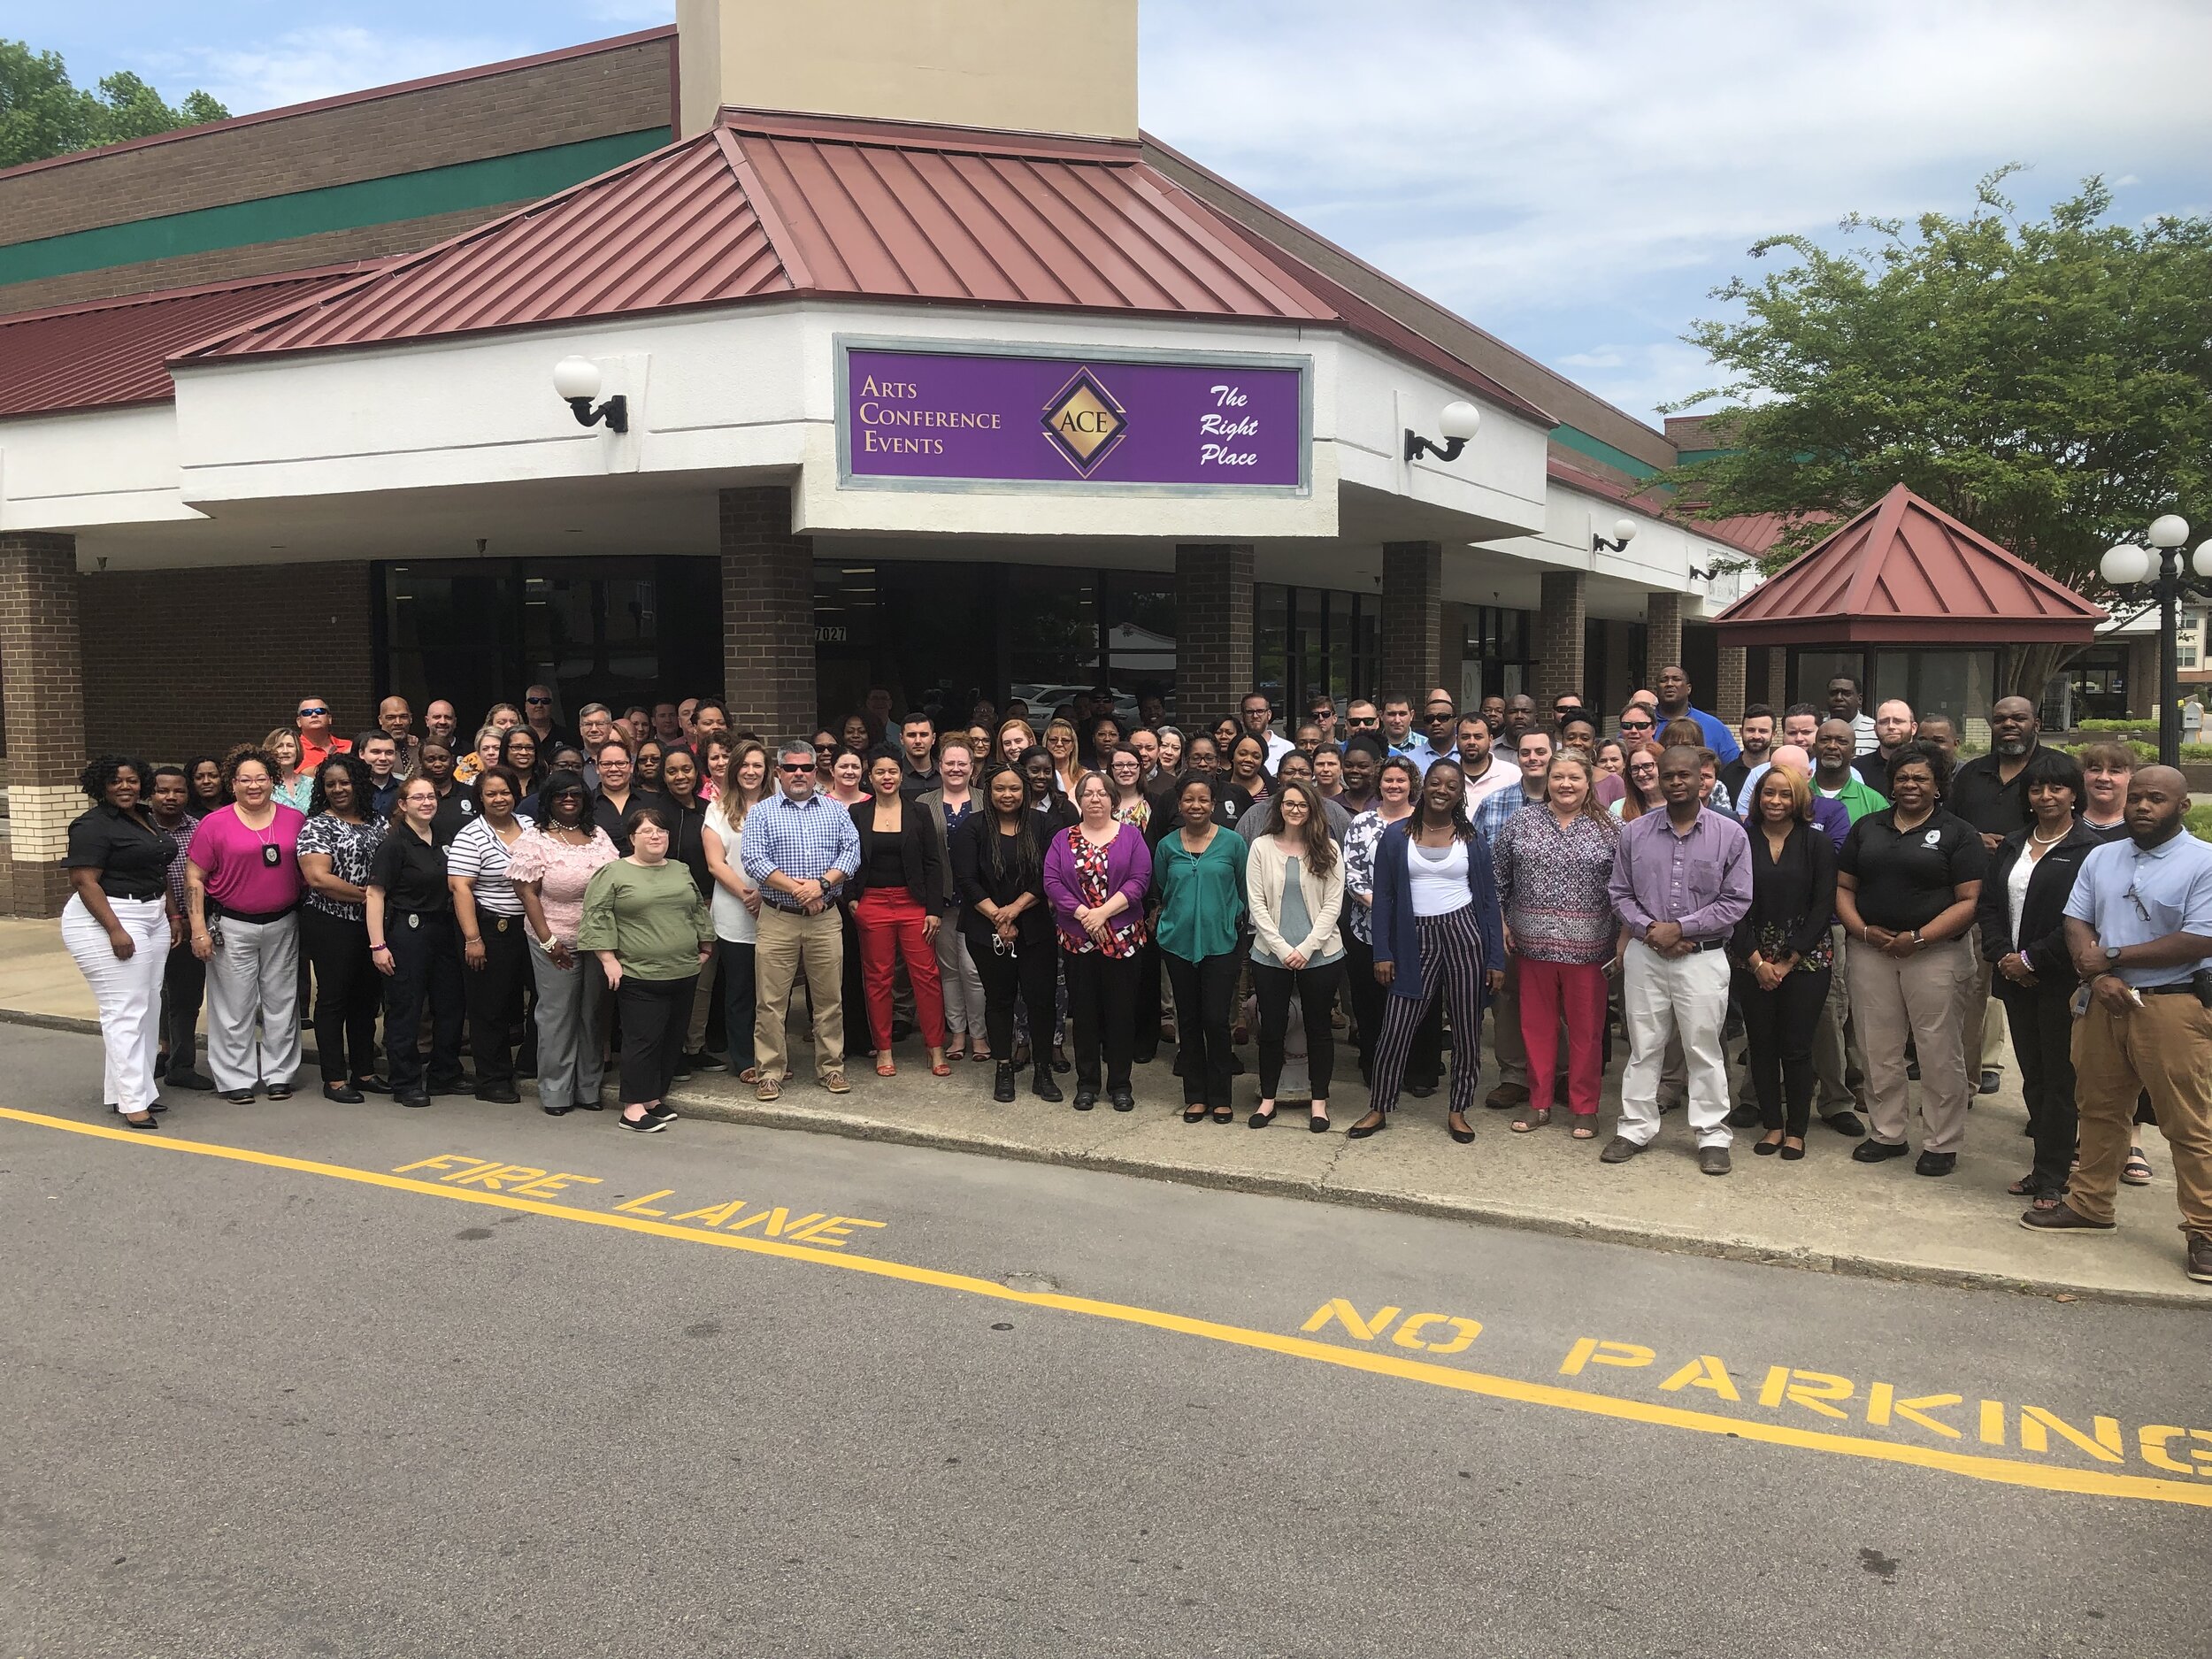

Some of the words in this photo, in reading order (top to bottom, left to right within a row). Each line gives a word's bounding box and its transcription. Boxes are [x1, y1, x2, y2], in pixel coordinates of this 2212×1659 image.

[859, 375, 918, 399] ARTS
[1210, 385, 1248, 407] The
[859, 402, 1002, 429] CONFERENCE
[1059, 411, 1108, 433] ACE
[1200, 413, 1259, 442] Right
[864, 430, 944, 454] EVENTS
[1200, 443, 1258, 465] Place
[814, 627, 845, 641] 7027
[391, 1154, 603, 1199] FIRE
[612, 1189, 888, 1247] LANE
[1300, 1297, 1484, 1354] NO
[1558, 1337, 2212, 1476] PARKING
